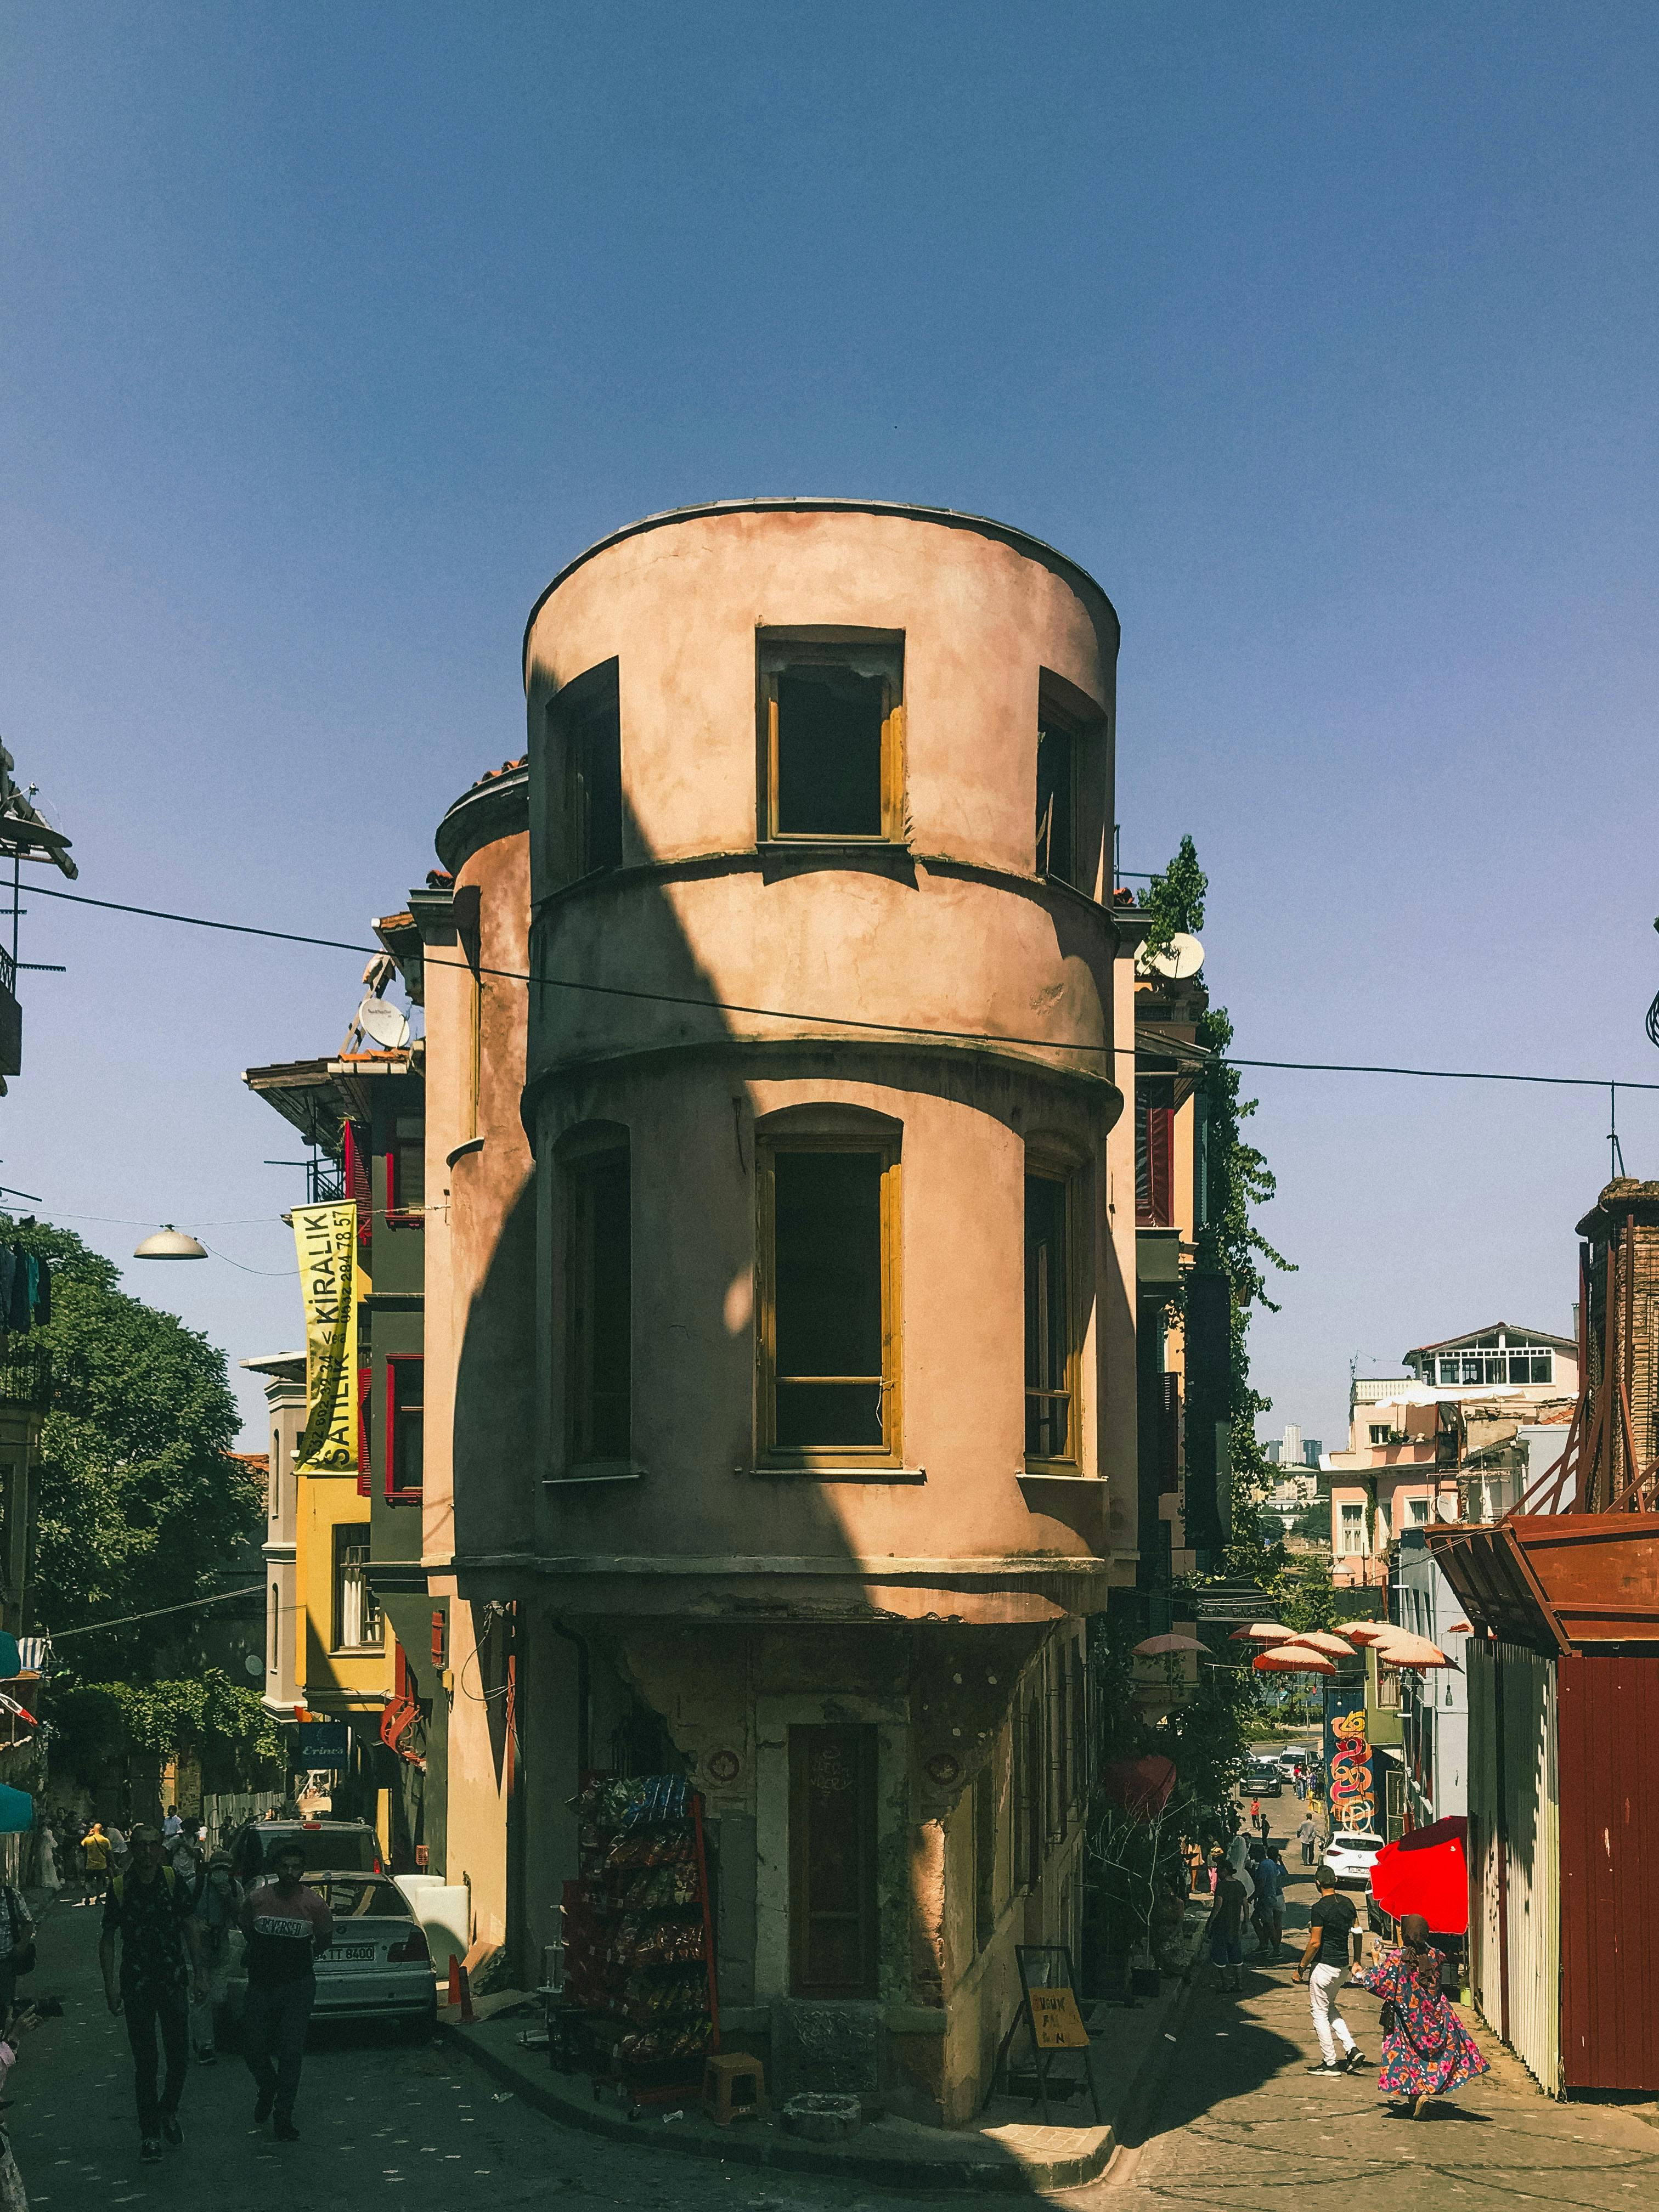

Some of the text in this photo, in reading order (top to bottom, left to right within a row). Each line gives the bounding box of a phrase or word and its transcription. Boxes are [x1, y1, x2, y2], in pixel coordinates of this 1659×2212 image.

[332, 1211, 351, 1227] 57
[335, 1232, 352, 1250] 78
[303, 1213, 339, 1324] KİRALIK
[324, 1353, 349, 1465] SATILIK
[261, 1918, 302, 1936] REVERSED
[346, 1947, 373, 1959] 8400
